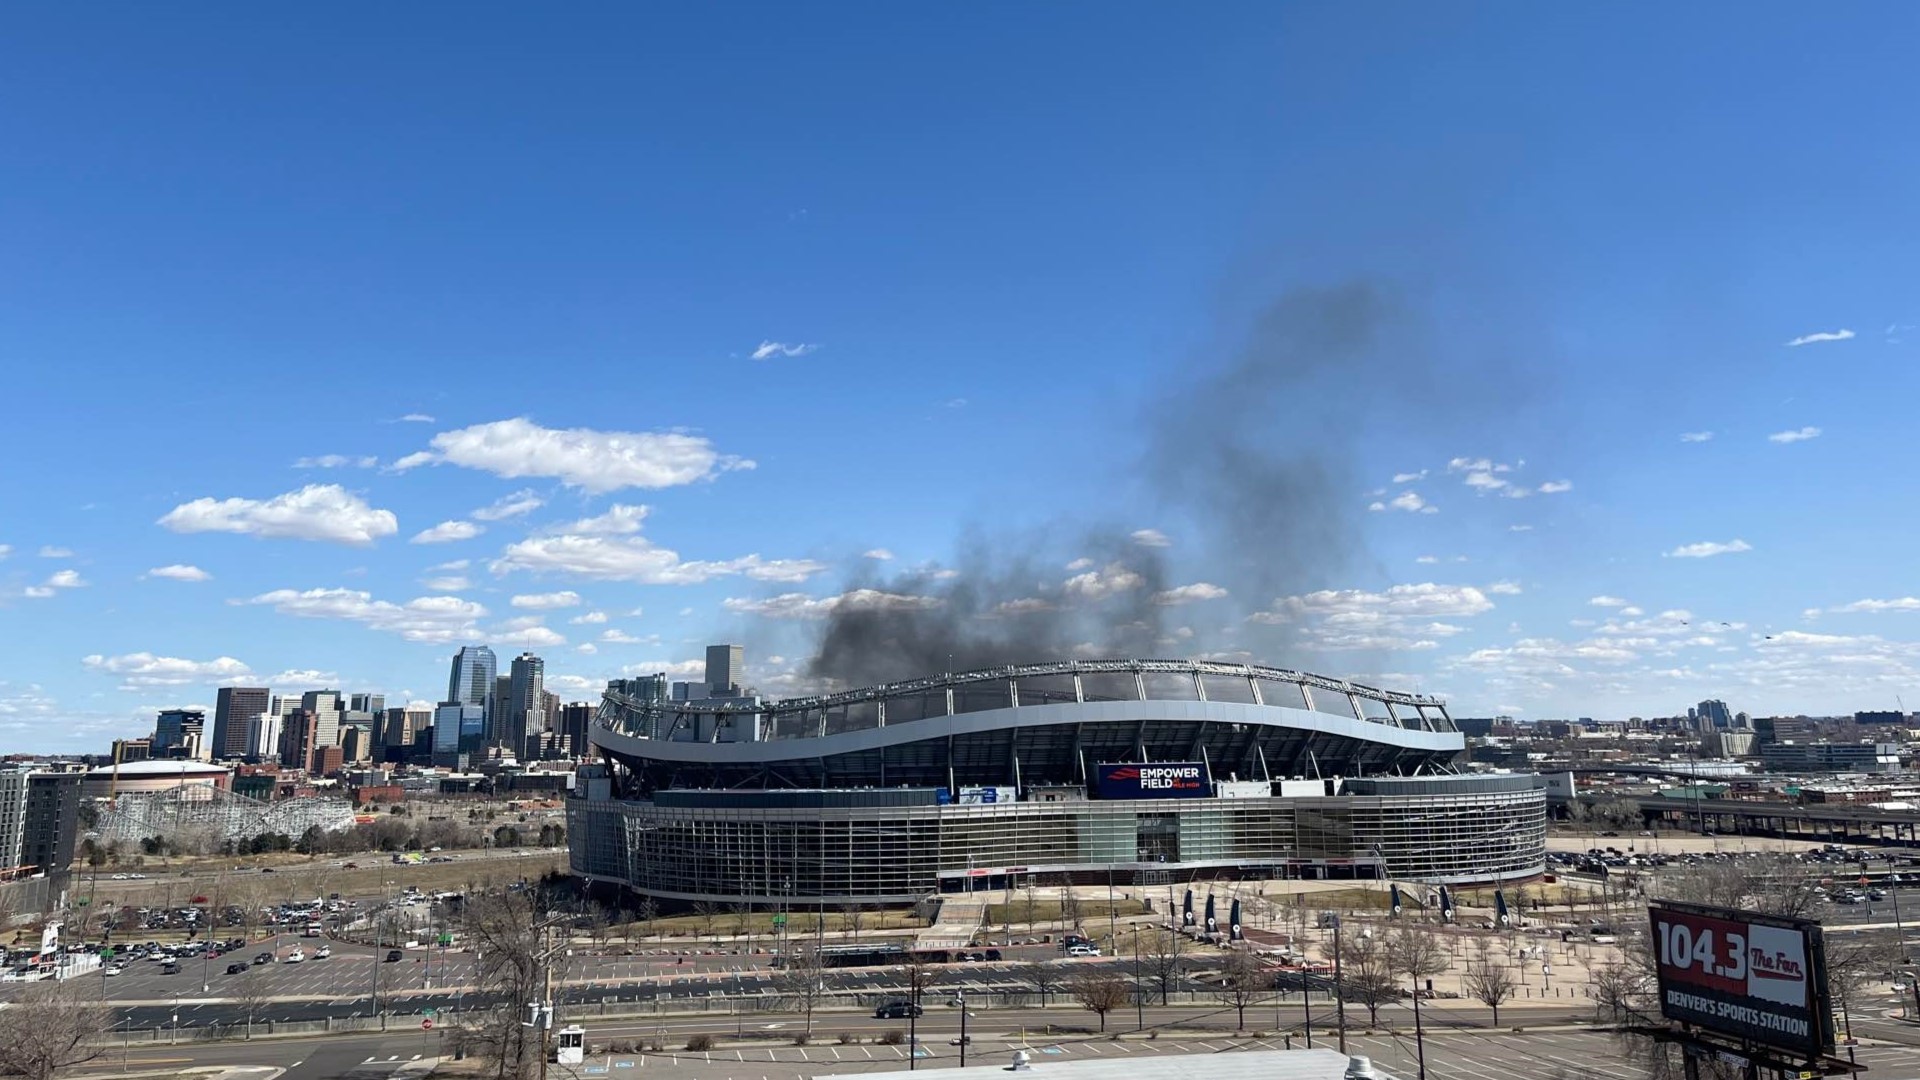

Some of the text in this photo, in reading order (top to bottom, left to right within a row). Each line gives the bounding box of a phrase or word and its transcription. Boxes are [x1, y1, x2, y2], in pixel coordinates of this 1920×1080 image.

[1140, 768, 1199, 778] EMPOWER
[1141, 778, 1173, 789] FIELD
[1658, 921, 1746, 980] 104.3
[1751, 948, 1802, 976] The Fan
[1667, 989, 1808, 1037] DENVER'S SPORTS STATION
